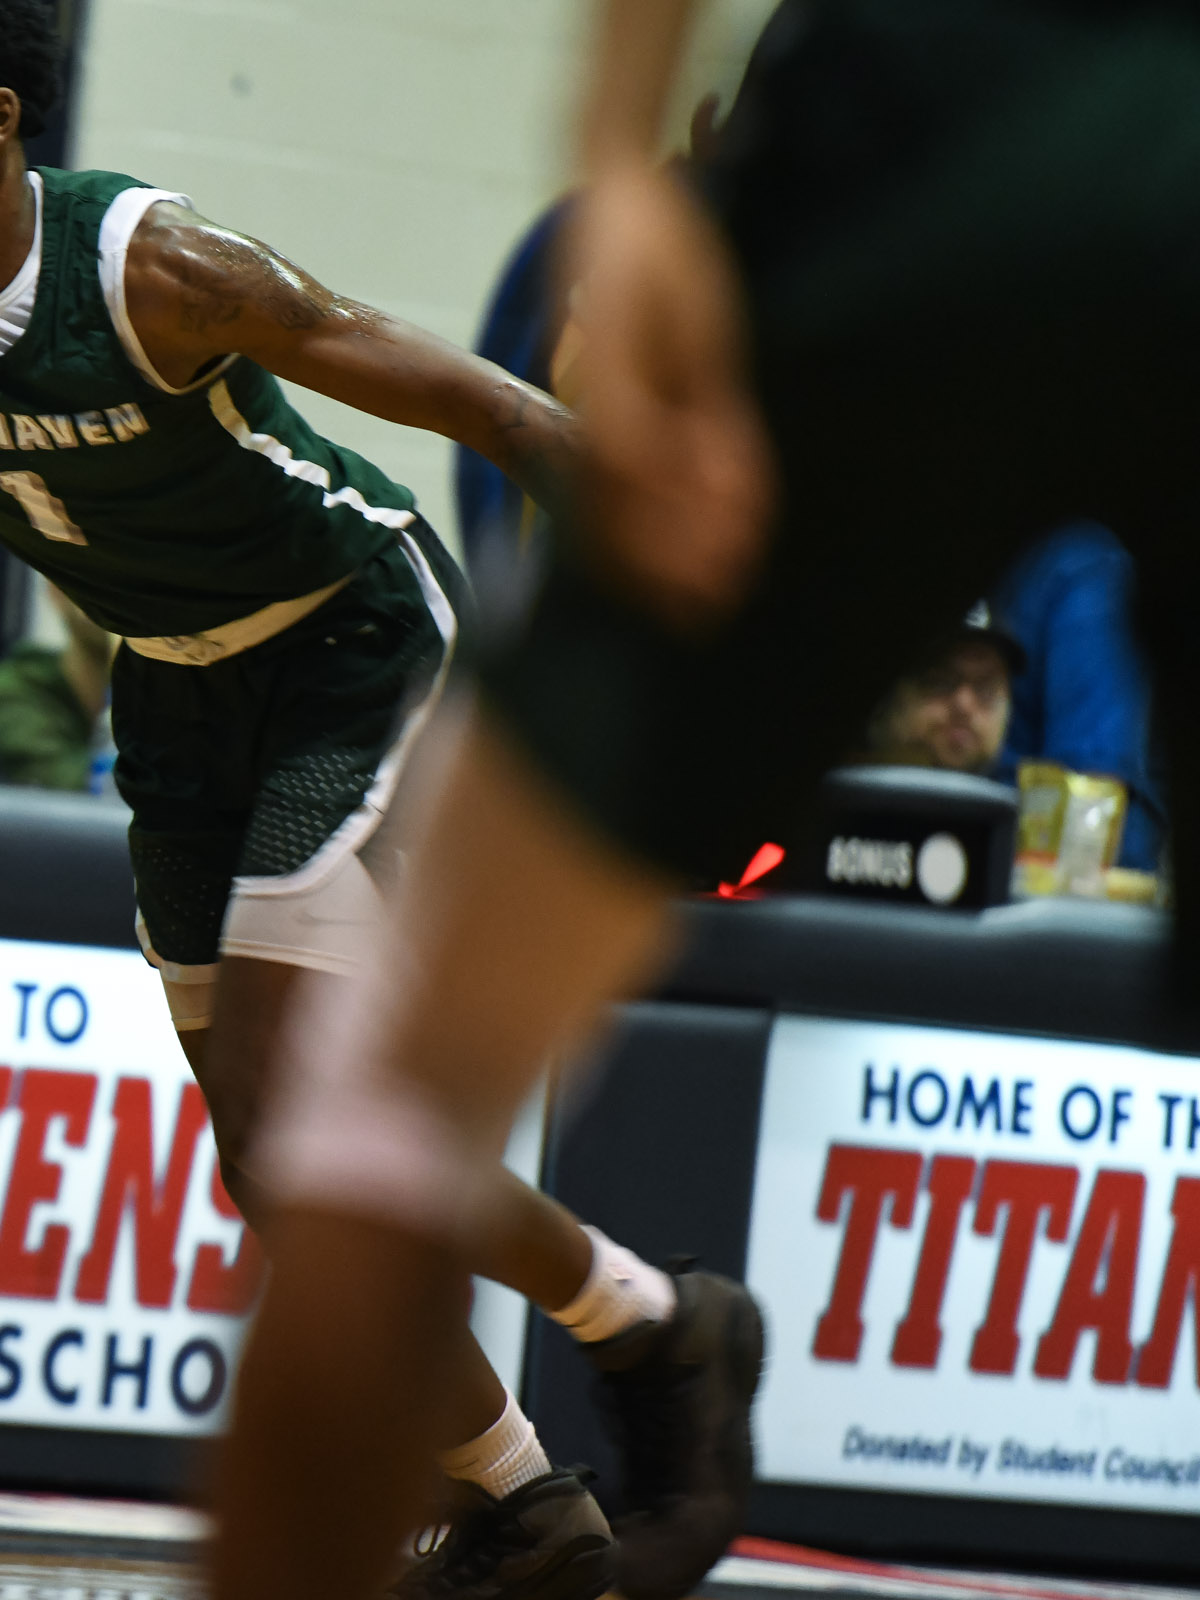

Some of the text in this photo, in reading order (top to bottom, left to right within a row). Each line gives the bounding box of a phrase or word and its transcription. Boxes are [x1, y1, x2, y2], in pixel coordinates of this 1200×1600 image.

[827, 836, 913, 889] BONUS
[13, 981, 89, 1046] TO
[860, 1062, 1035, 1136] HOME
[1060, 1084, 1133, 1144] OF
[842, 1426, 952, 1466] Donated
[956, 1434, 991, 1477] by
[996, 1436, 1098, 1476] Student
